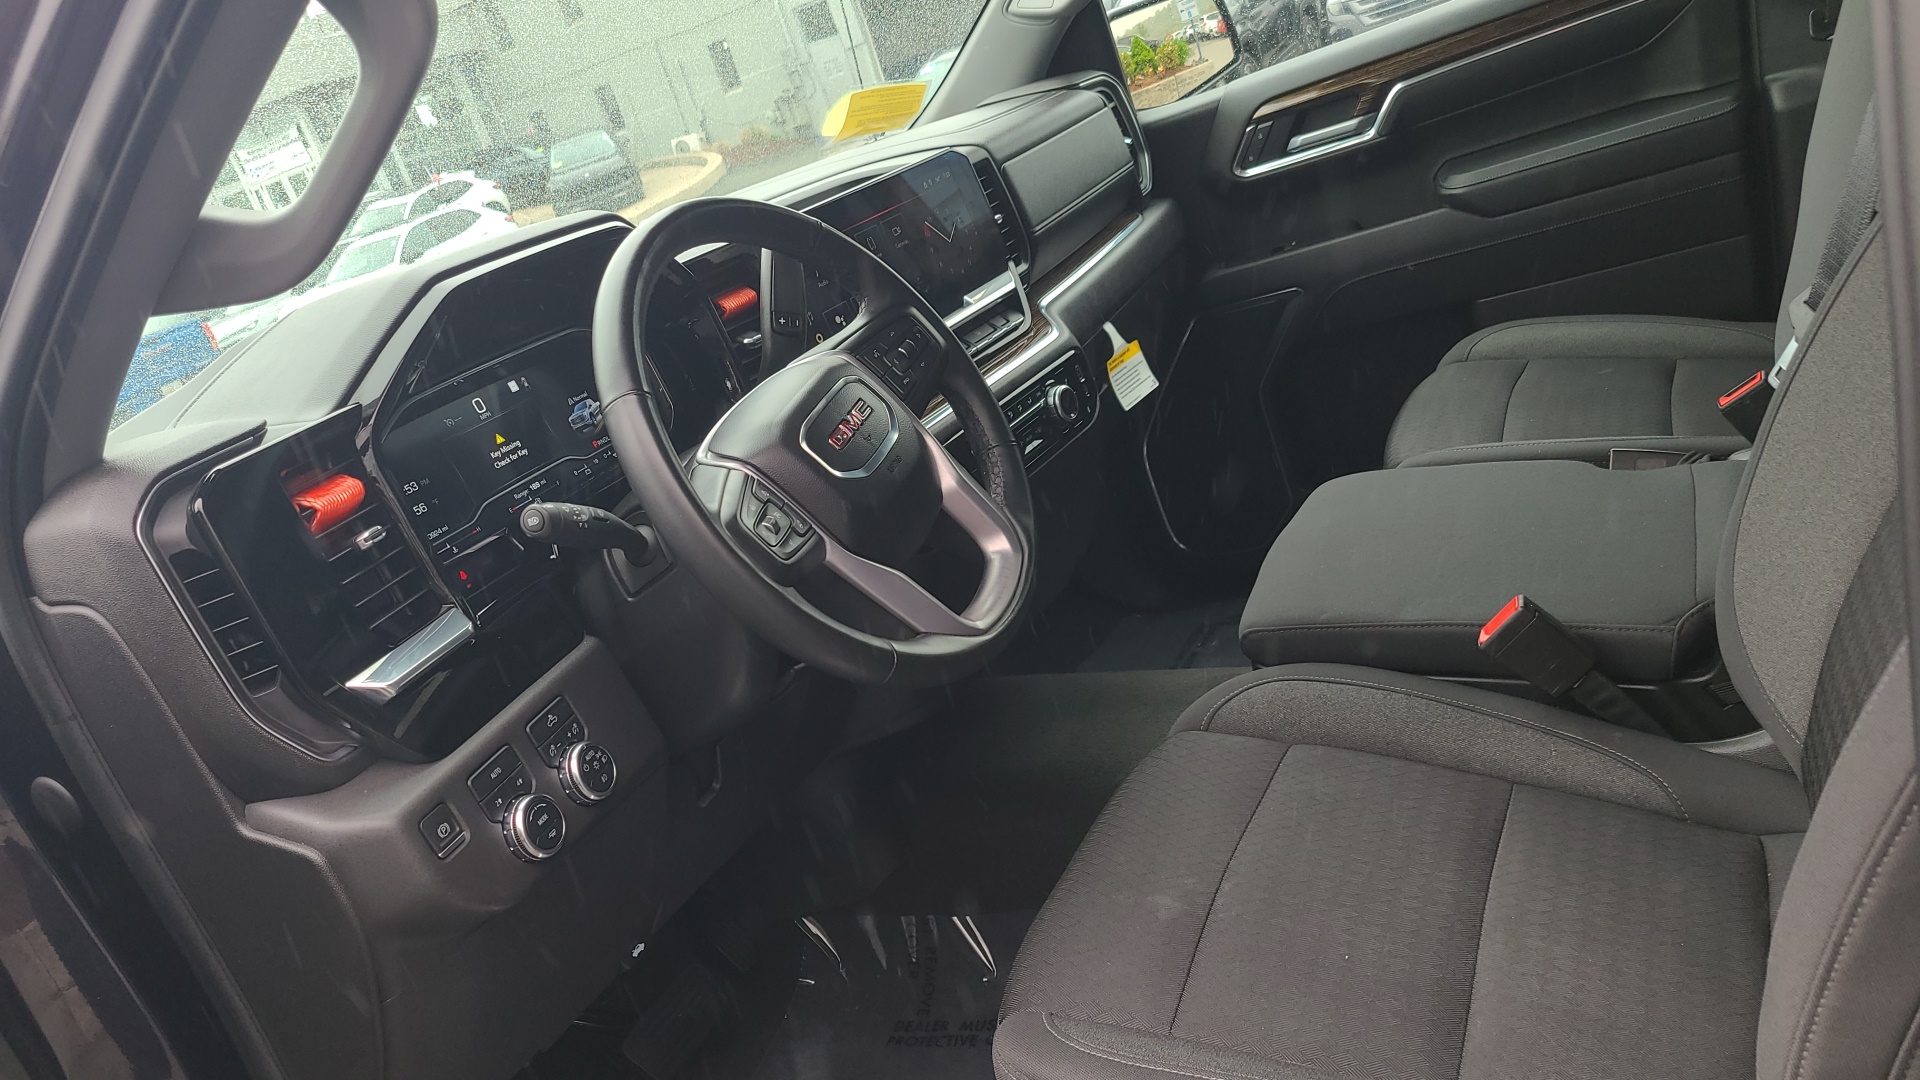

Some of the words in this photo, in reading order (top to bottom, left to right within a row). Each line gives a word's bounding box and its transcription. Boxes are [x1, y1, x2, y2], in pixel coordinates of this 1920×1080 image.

[572, 390, 589, 403] Normal
[471, 397, 487, 414] 0
[479, 410, 492, 421] MPH
[828, 397, 874, 451] GMC
[489, 451, 502, 459] Key
[499, 440, 522, 454] Missing
[494, 456, 512, 469] Check
[509, 453, 519, 461] for
[517, 448, 529, 457] Key
[419, 478, 431, 487] PM
[412, 502, 428, 516] 56
[585, 749, 595, 762] AUTO
[490, 766, 502, 780] AUTO
[537, 812, 549, 826] MODE
[916, 945, 937, 1017] REMOVE
[892, 1019, 950, 1033] DEALER
[958, 1018, 998, 1032] MUS
[886, 1034, 980, 1048] PROTECTIVE
